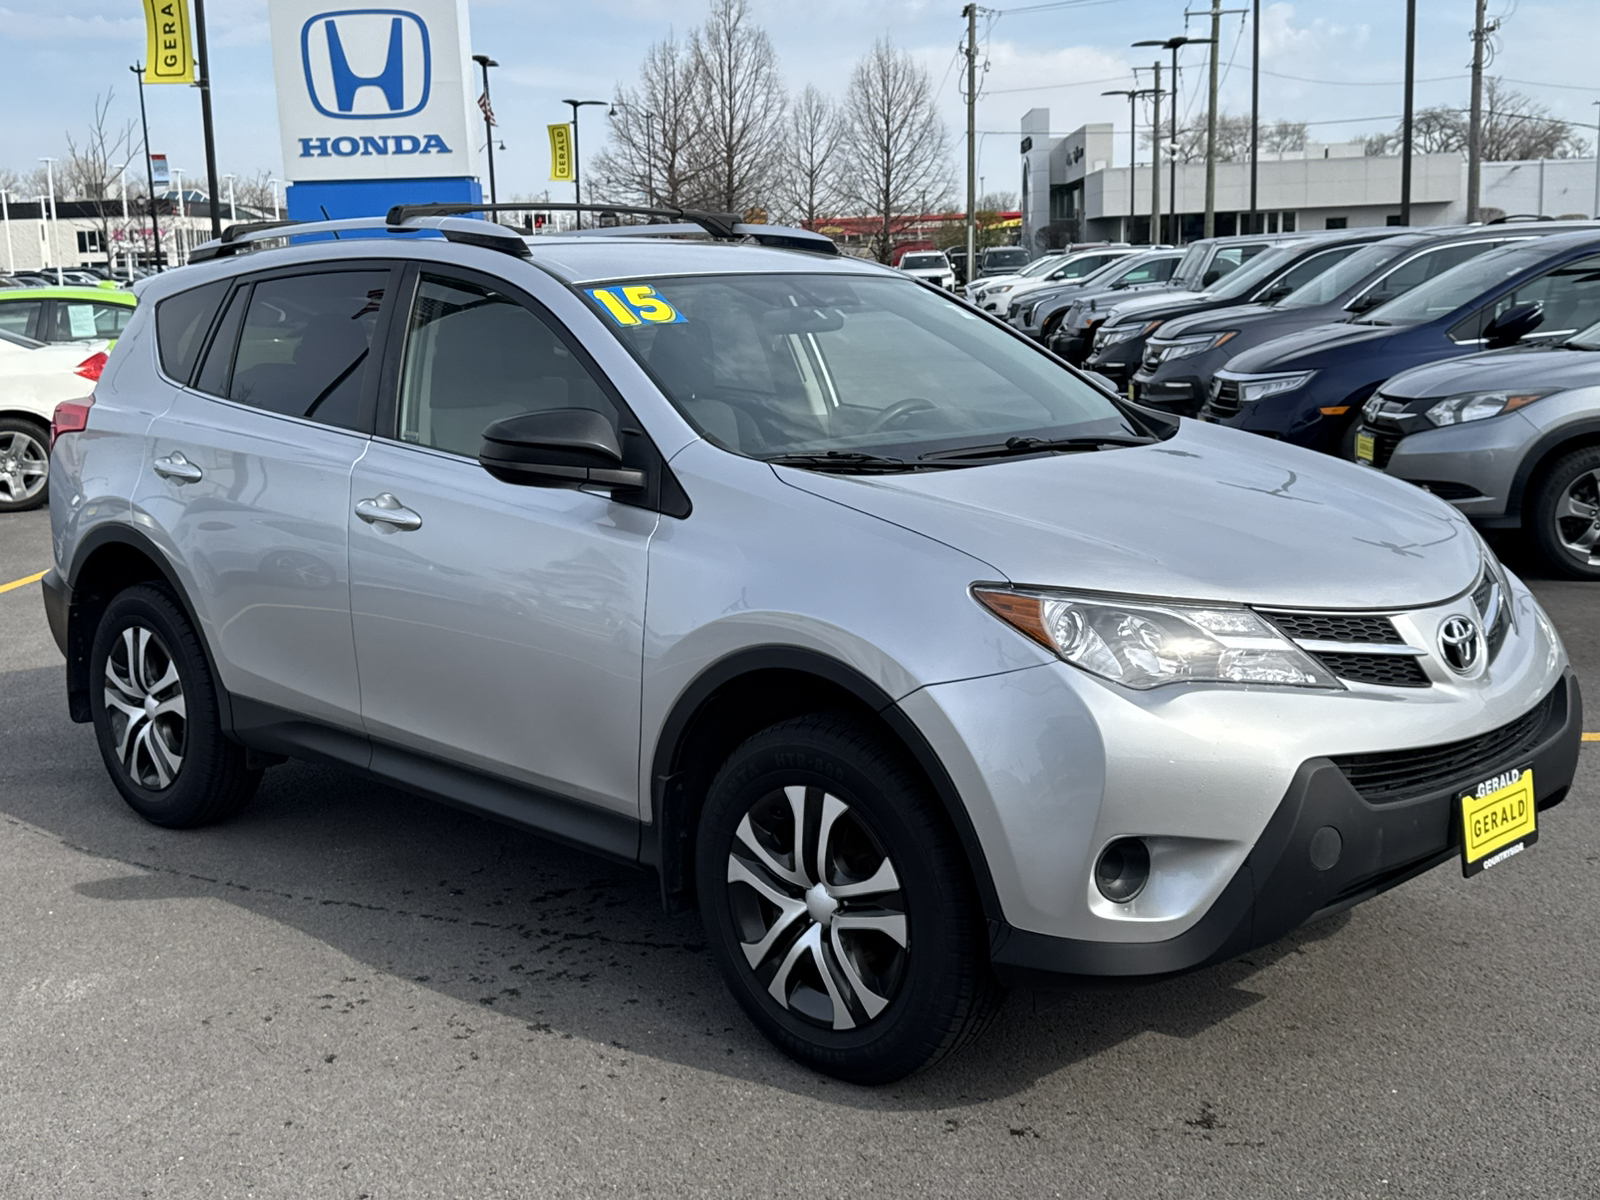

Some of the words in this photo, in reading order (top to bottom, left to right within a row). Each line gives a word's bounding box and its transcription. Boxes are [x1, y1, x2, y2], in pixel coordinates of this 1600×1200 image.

[161, 3, 177, 68] GERA
[298, 134, 453, 157] HONDA
[556, 130, 567, 174] GERALD
[592, 285, 677, 325] 15
[1477, 769, 1520, 797] GERALD
[1474, 800, 1525, 838] GERALD
[1483, 842, 1525, 869] COUNTRYSIDE
